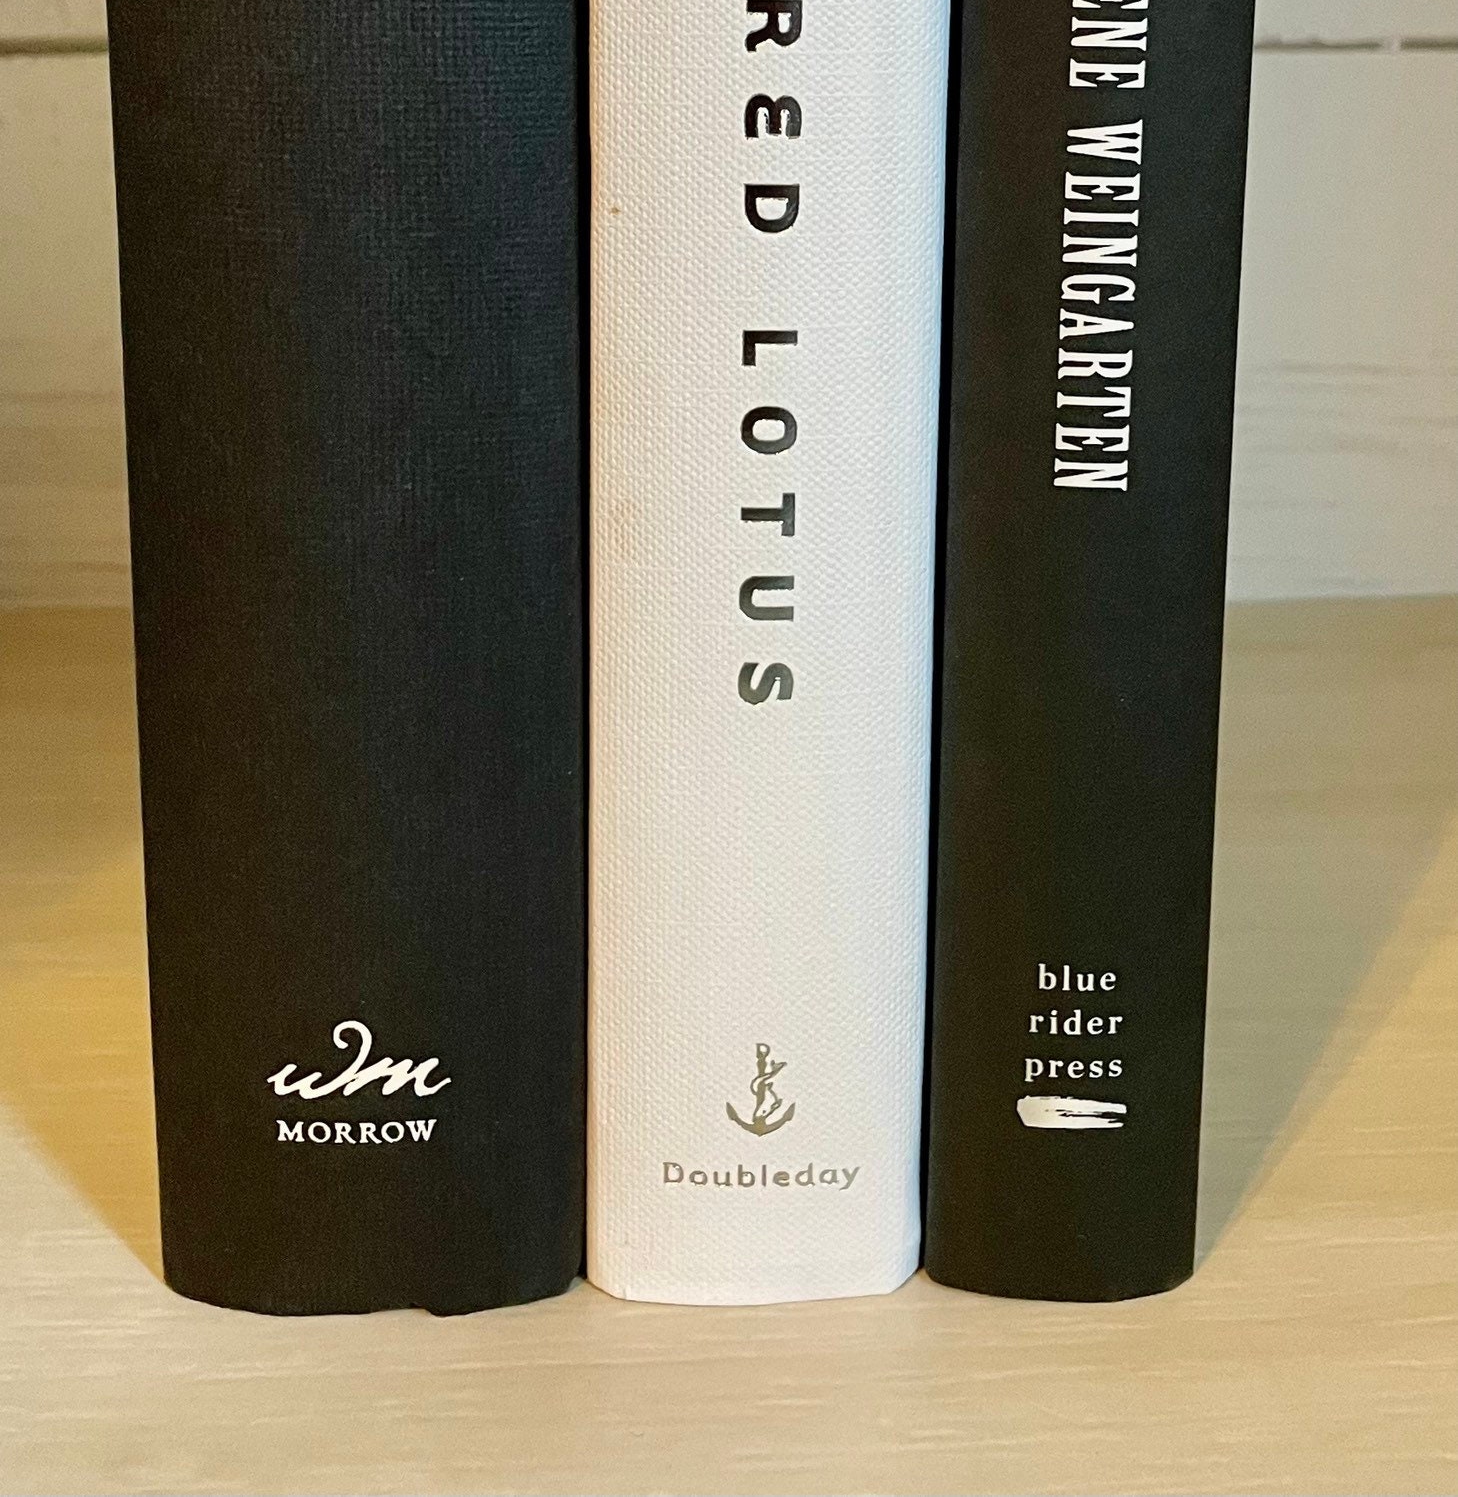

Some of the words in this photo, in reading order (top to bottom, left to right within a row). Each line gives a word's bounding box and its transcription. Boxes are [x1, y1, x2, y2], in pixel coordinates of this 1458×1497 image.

[1052, 118, 1145, 493] WEINGARTEN
[736, 328, 799, 708] LOTUS
[1037, 962, 1118, 992] blue
[1027, 1008, 1124, 1036] rider
[1023, 1057, 1124, 1083] press
[275, 1118, 438, 1145] MORROW
[661, 1160, 862, 1191] Doubleday
